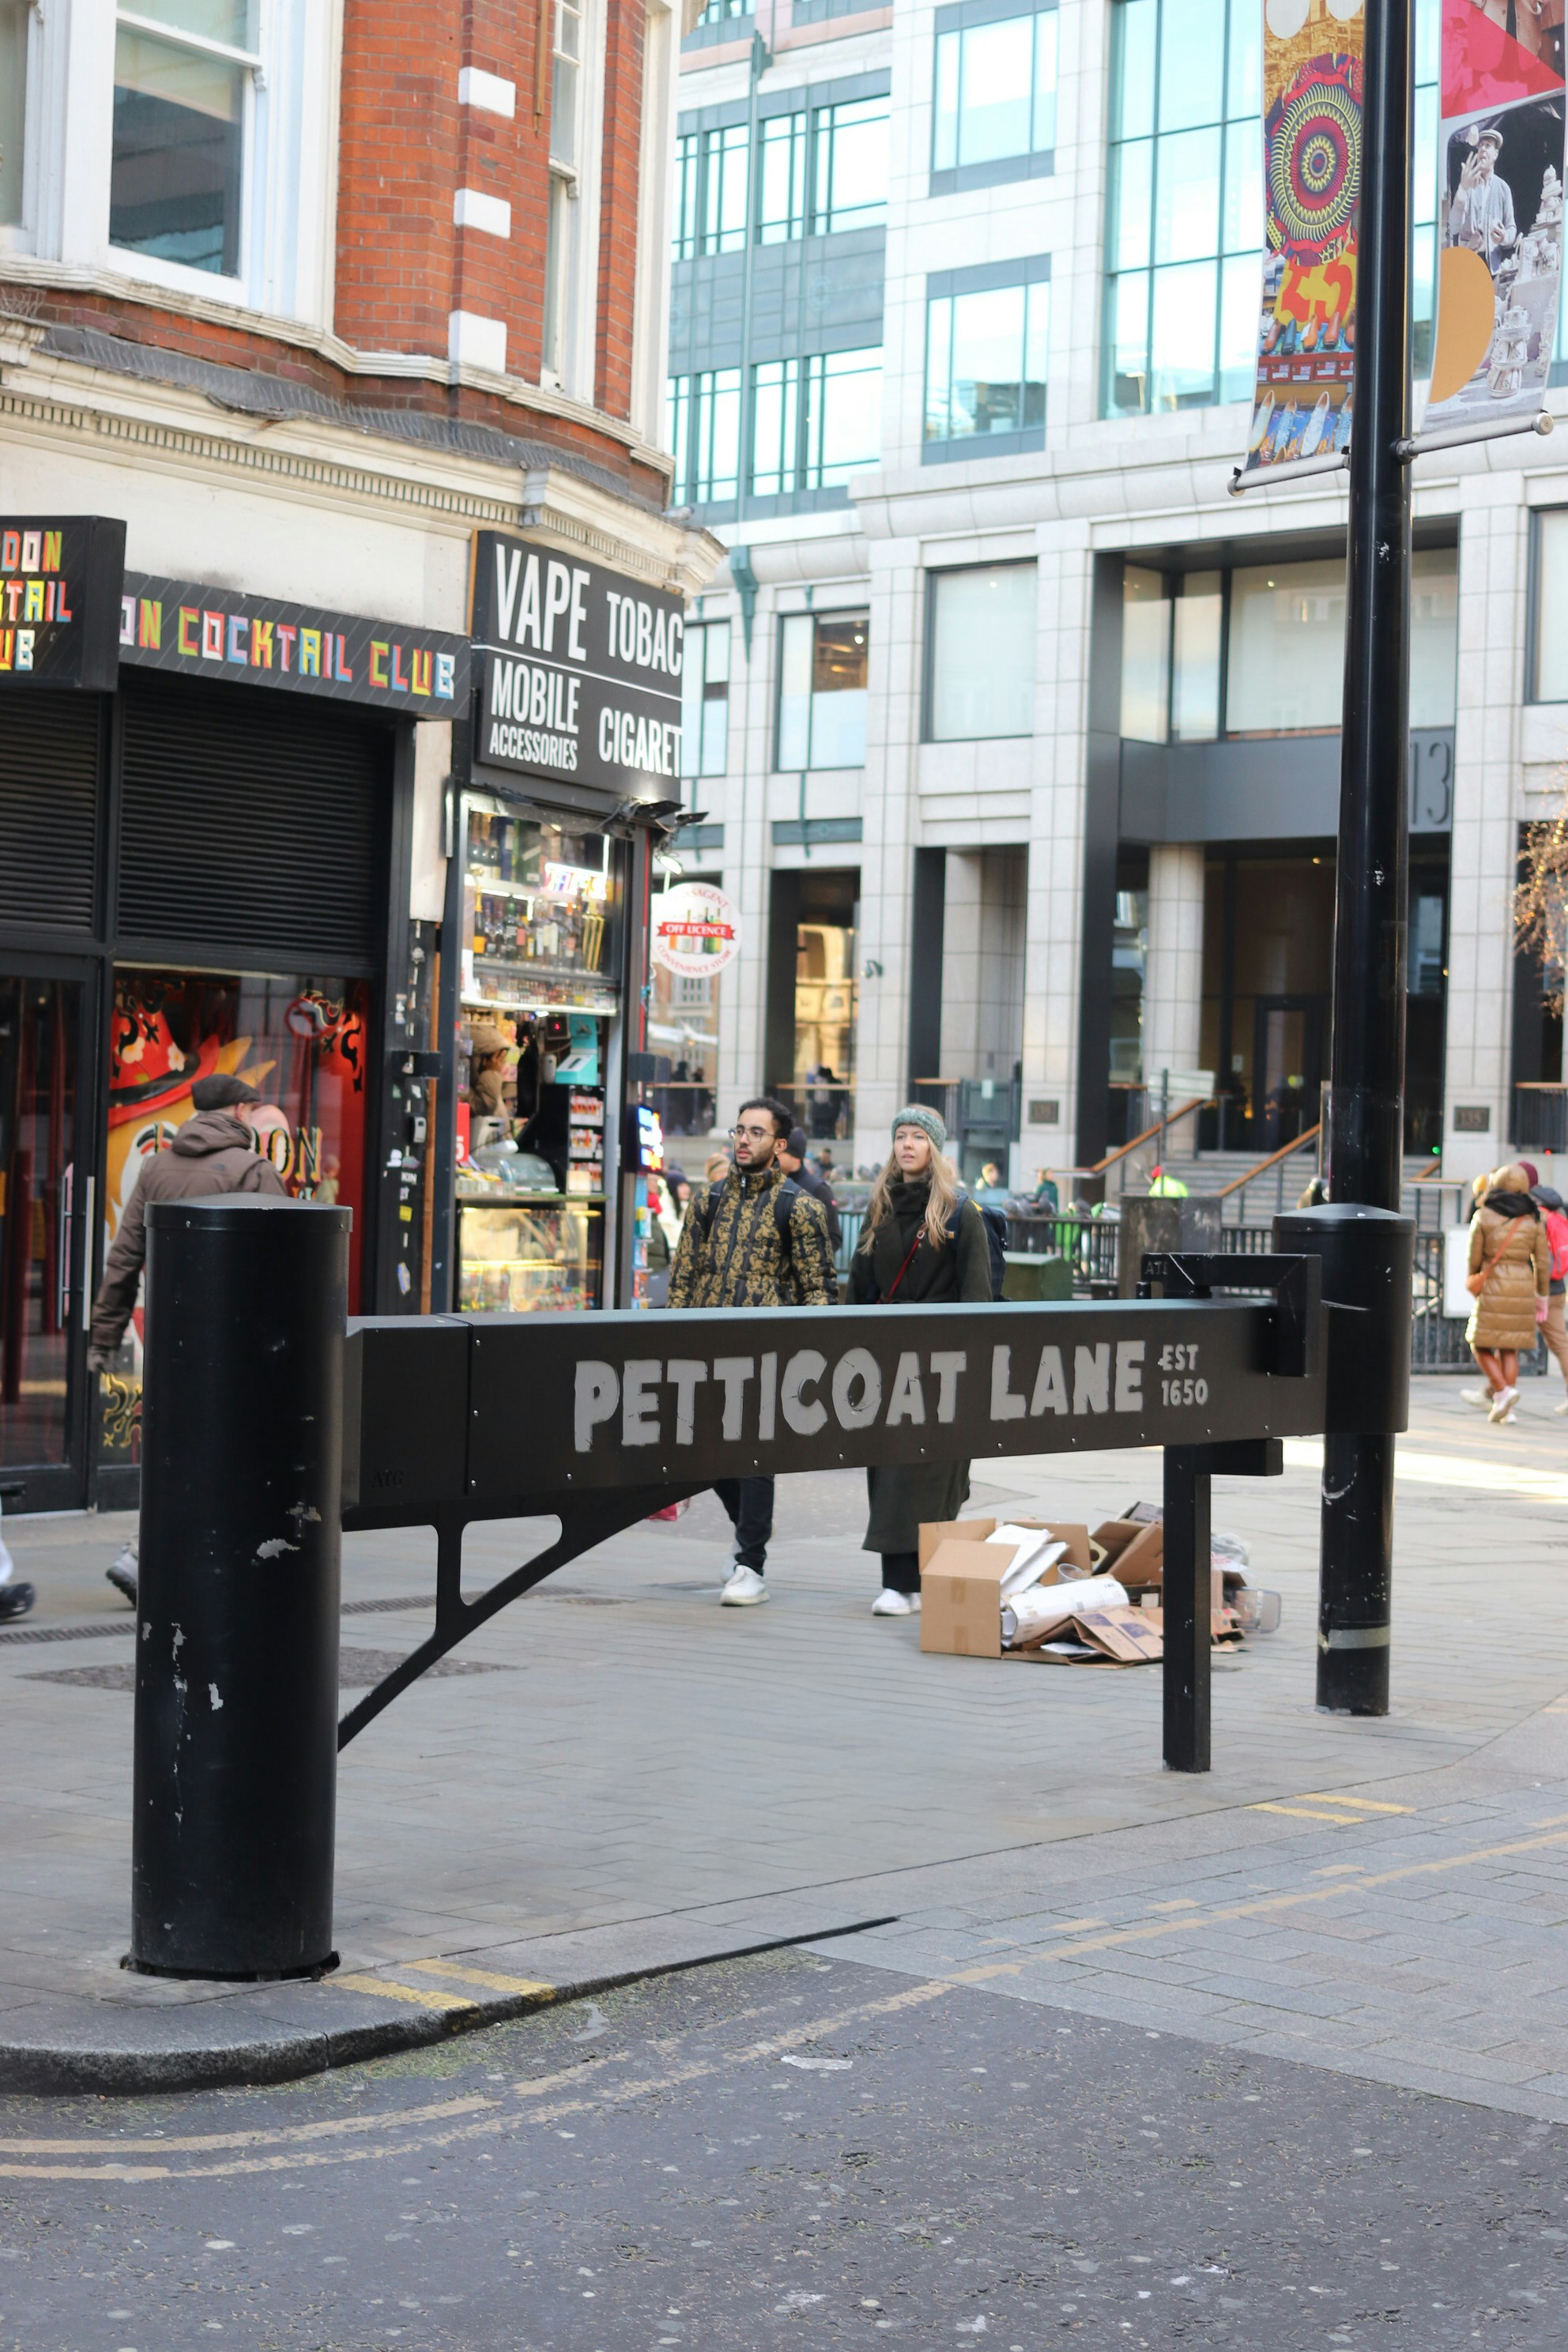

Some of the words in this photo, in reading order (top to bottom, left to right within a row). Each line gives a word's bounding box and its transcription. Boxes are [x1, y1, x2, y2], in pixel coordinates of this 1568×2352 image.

[0, 580, 72, 623] TAIL
[496, 543, 591, 662] VAPE
[178, 605, 352, 682] COCKTAIL
[370, 641, 456, 700] CLUB
[606, 591, 684, 677] TOBAC
[491, 658, 581, 734] MOBILE
[488, 722, 578, 771] ACCESSORIES
[598, 707, 683, 778] CIGARET
[658, 944, 709, 973] CONVENIENCE
[665, 924, 685, 934] OFF
[687, 925, 726, 937] LICENCE
[1161, 1344, 1199, 1371] EST
[574, 1347, 967, 1453] PETTICOAT
[989, 1340, 1146, 1422] LANE
[1161, 1378, 1209, 1407] 1650
